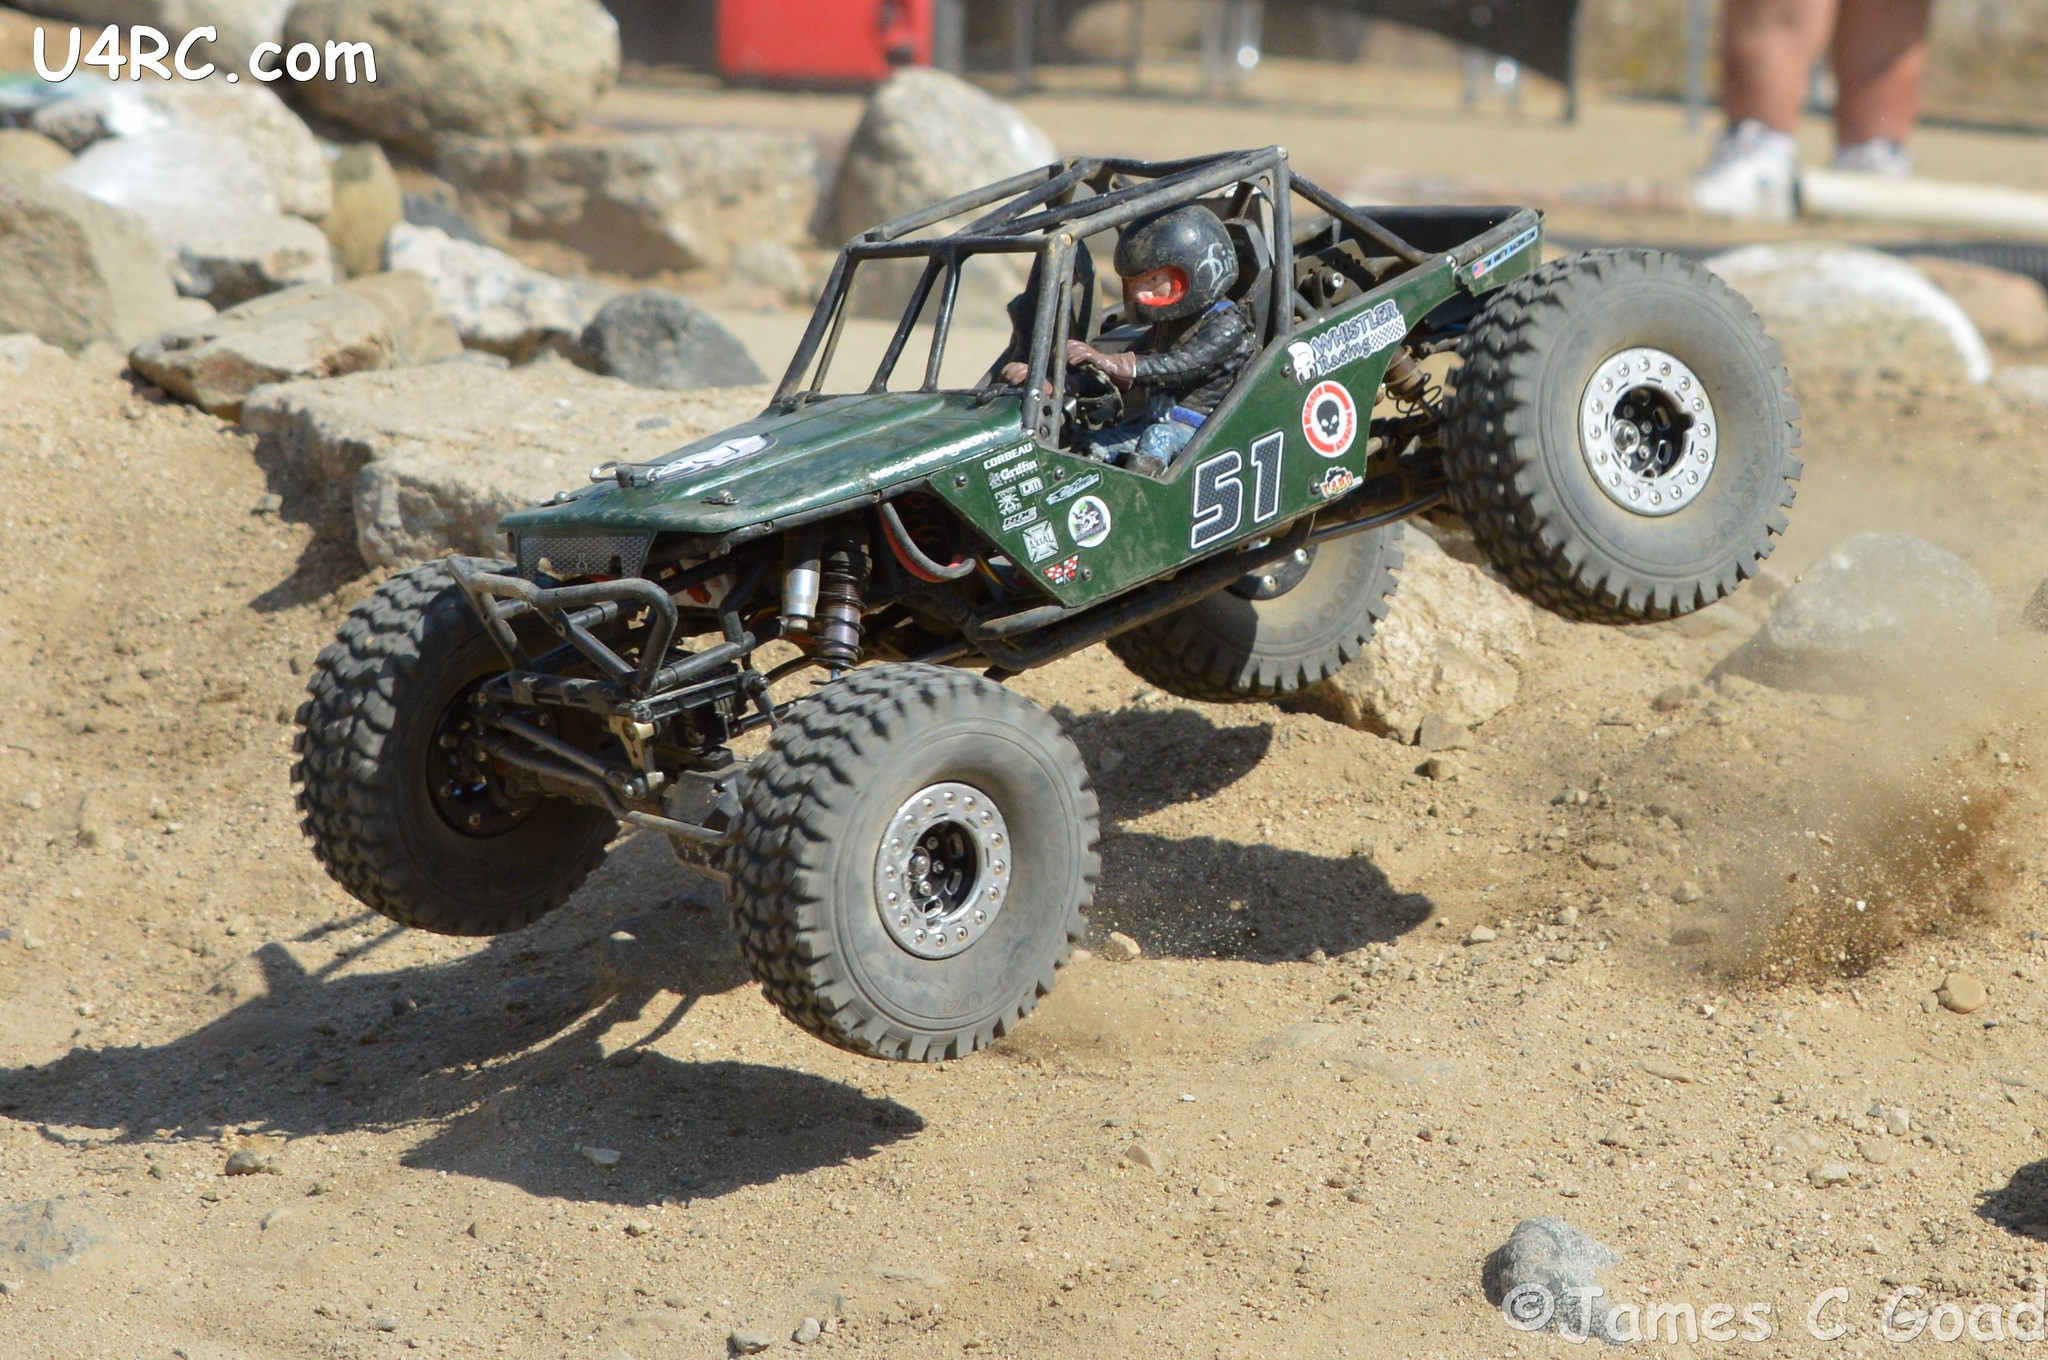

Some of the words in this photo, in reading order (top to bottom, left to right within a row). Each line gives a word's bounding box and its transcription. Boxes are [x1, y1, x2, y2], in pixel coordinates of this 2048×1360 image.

[1312, 301, 1397, 356] WHISTLER
[1319, 336, 1372, 373] Racing
[983, 442, 1033, 470] CORBEAU
[1000, 460, 1038, 480] Griffin
[1190, 429, 1285, 550] 51
